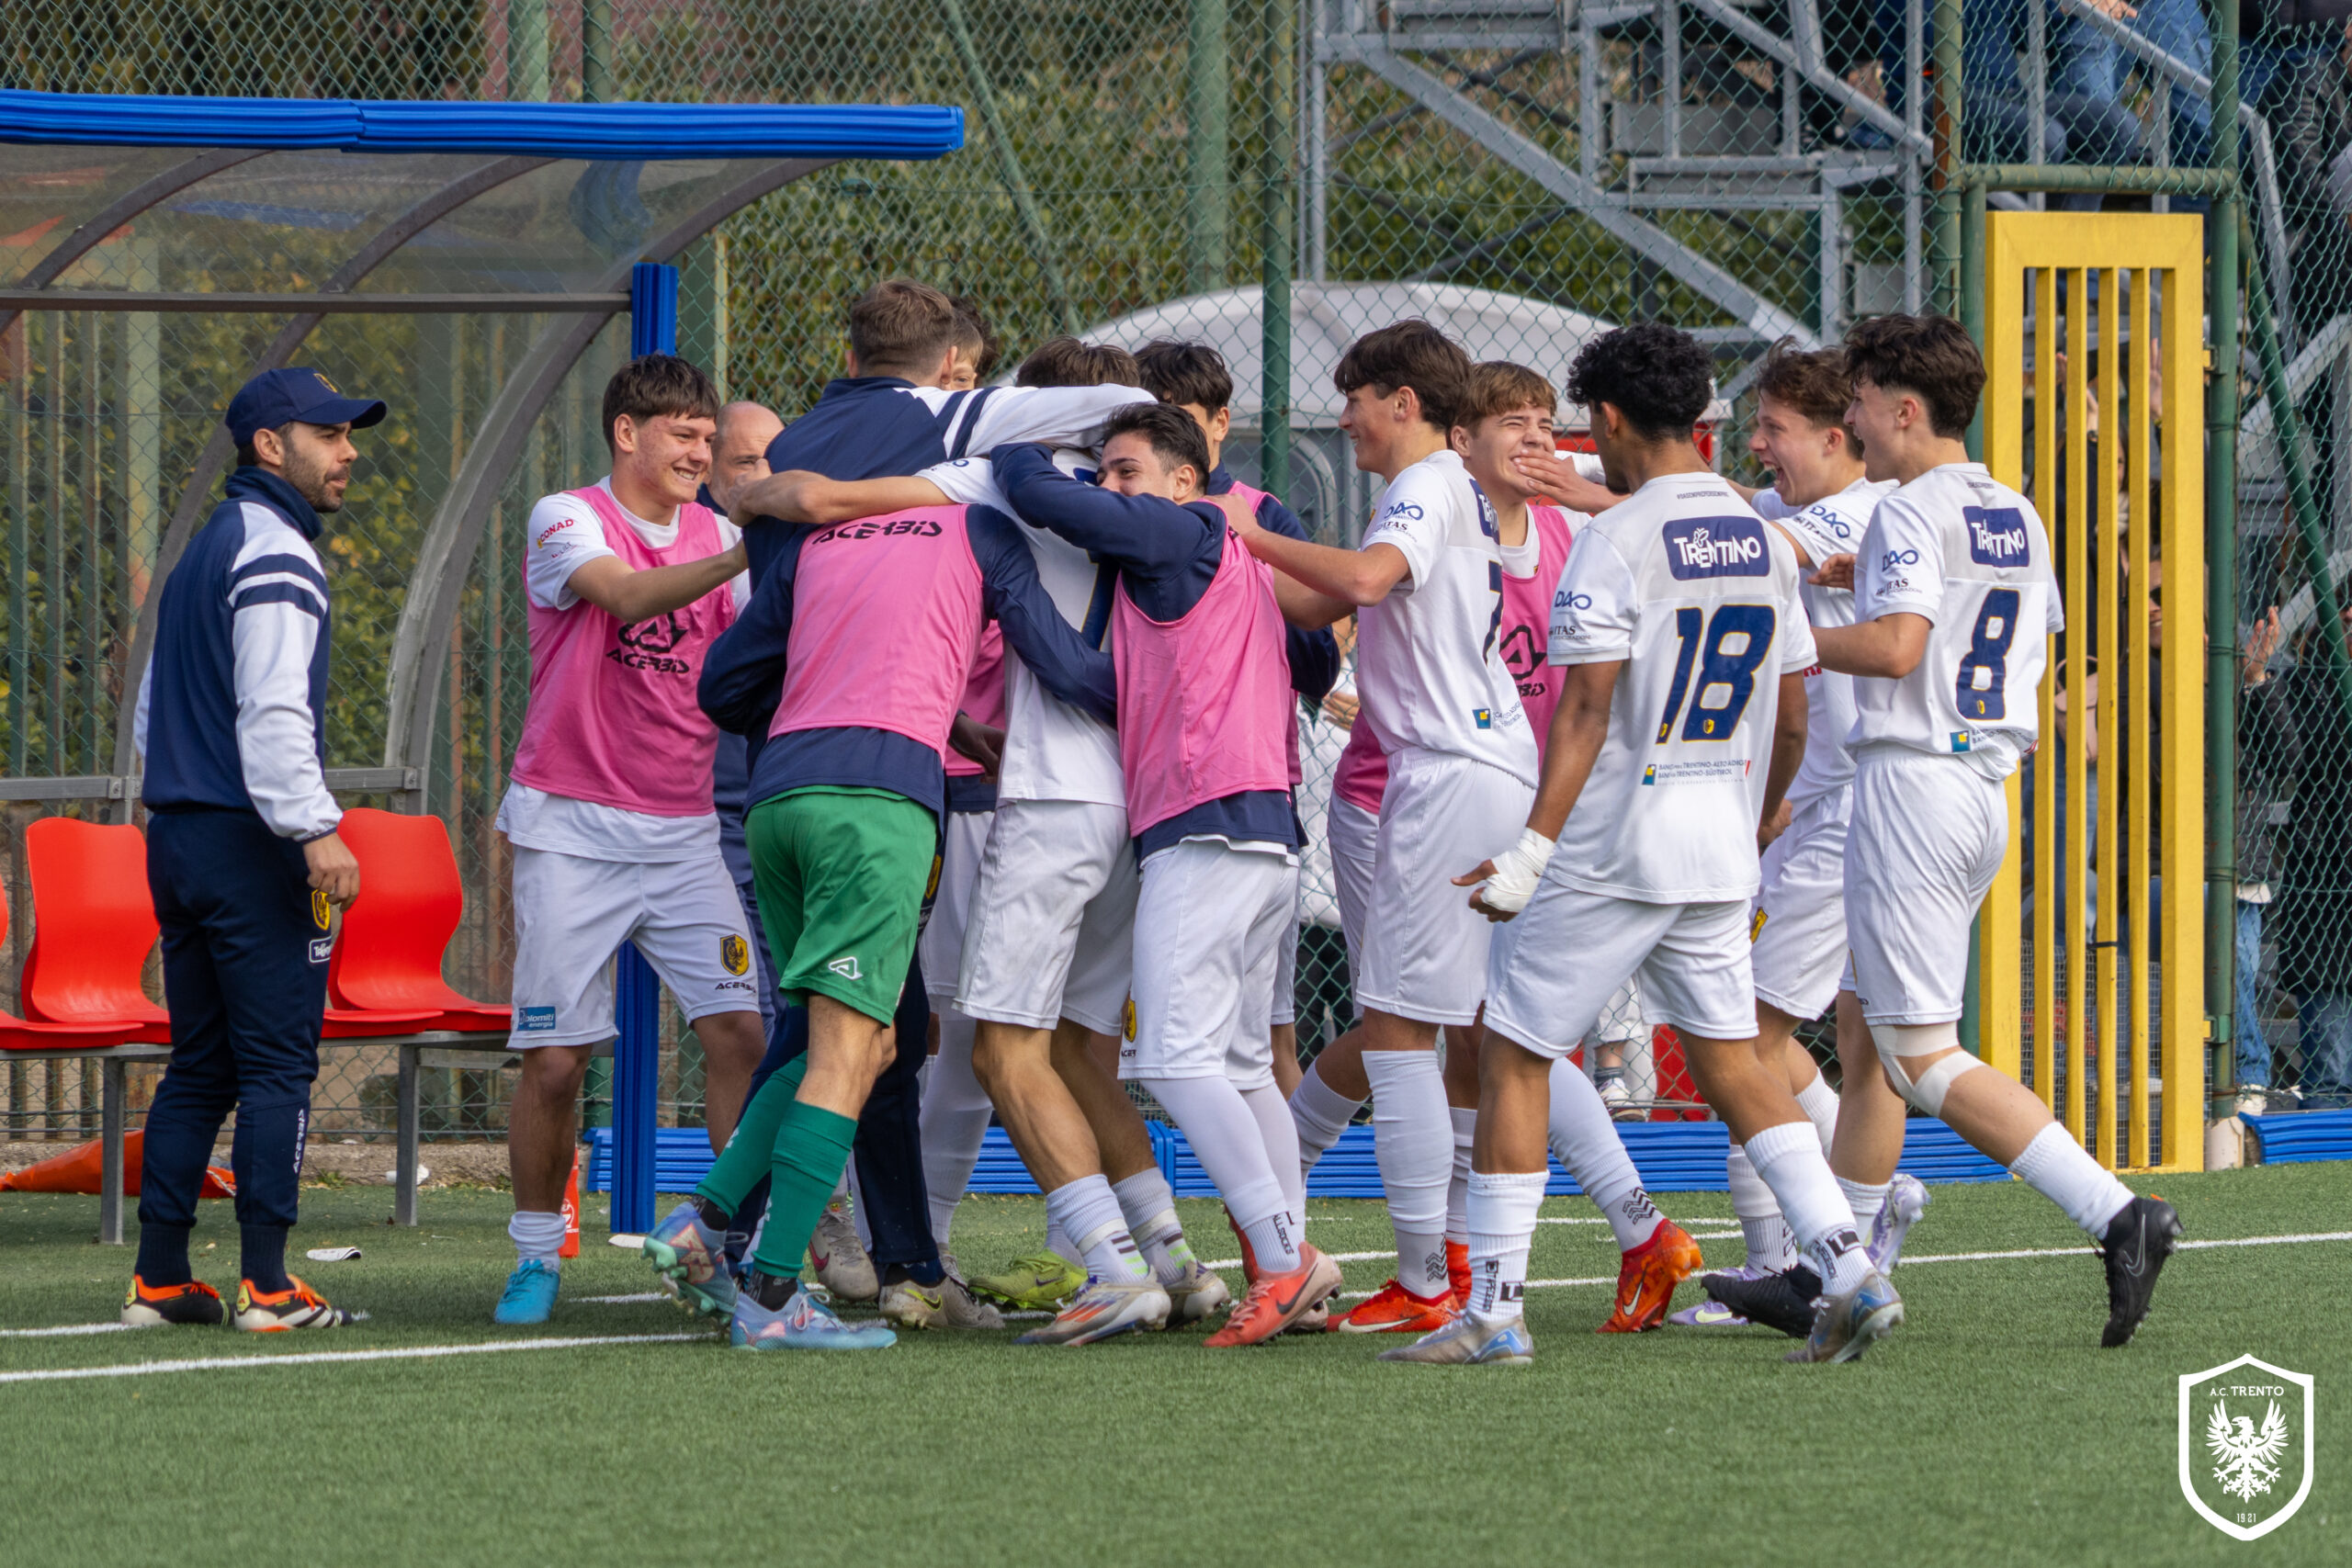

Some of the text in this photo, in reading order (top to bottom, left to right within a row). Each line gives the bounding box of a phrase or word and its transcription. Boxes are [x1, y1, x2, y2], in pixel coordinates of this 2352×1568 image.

[540, 519, 574, 542] CONAD
[812, 521, 943, 545] ACERBIS
[1673, 535, 1761, 569] TRENTINO
[1555, 591, 1592, 610] DAO
[1555, 625, 1577, 636] ITAS
[606, 648, 690, 674] ACERBIS
[1956, 587, 2020, 720] 8
[1655, 604, 1776, 745] 18
